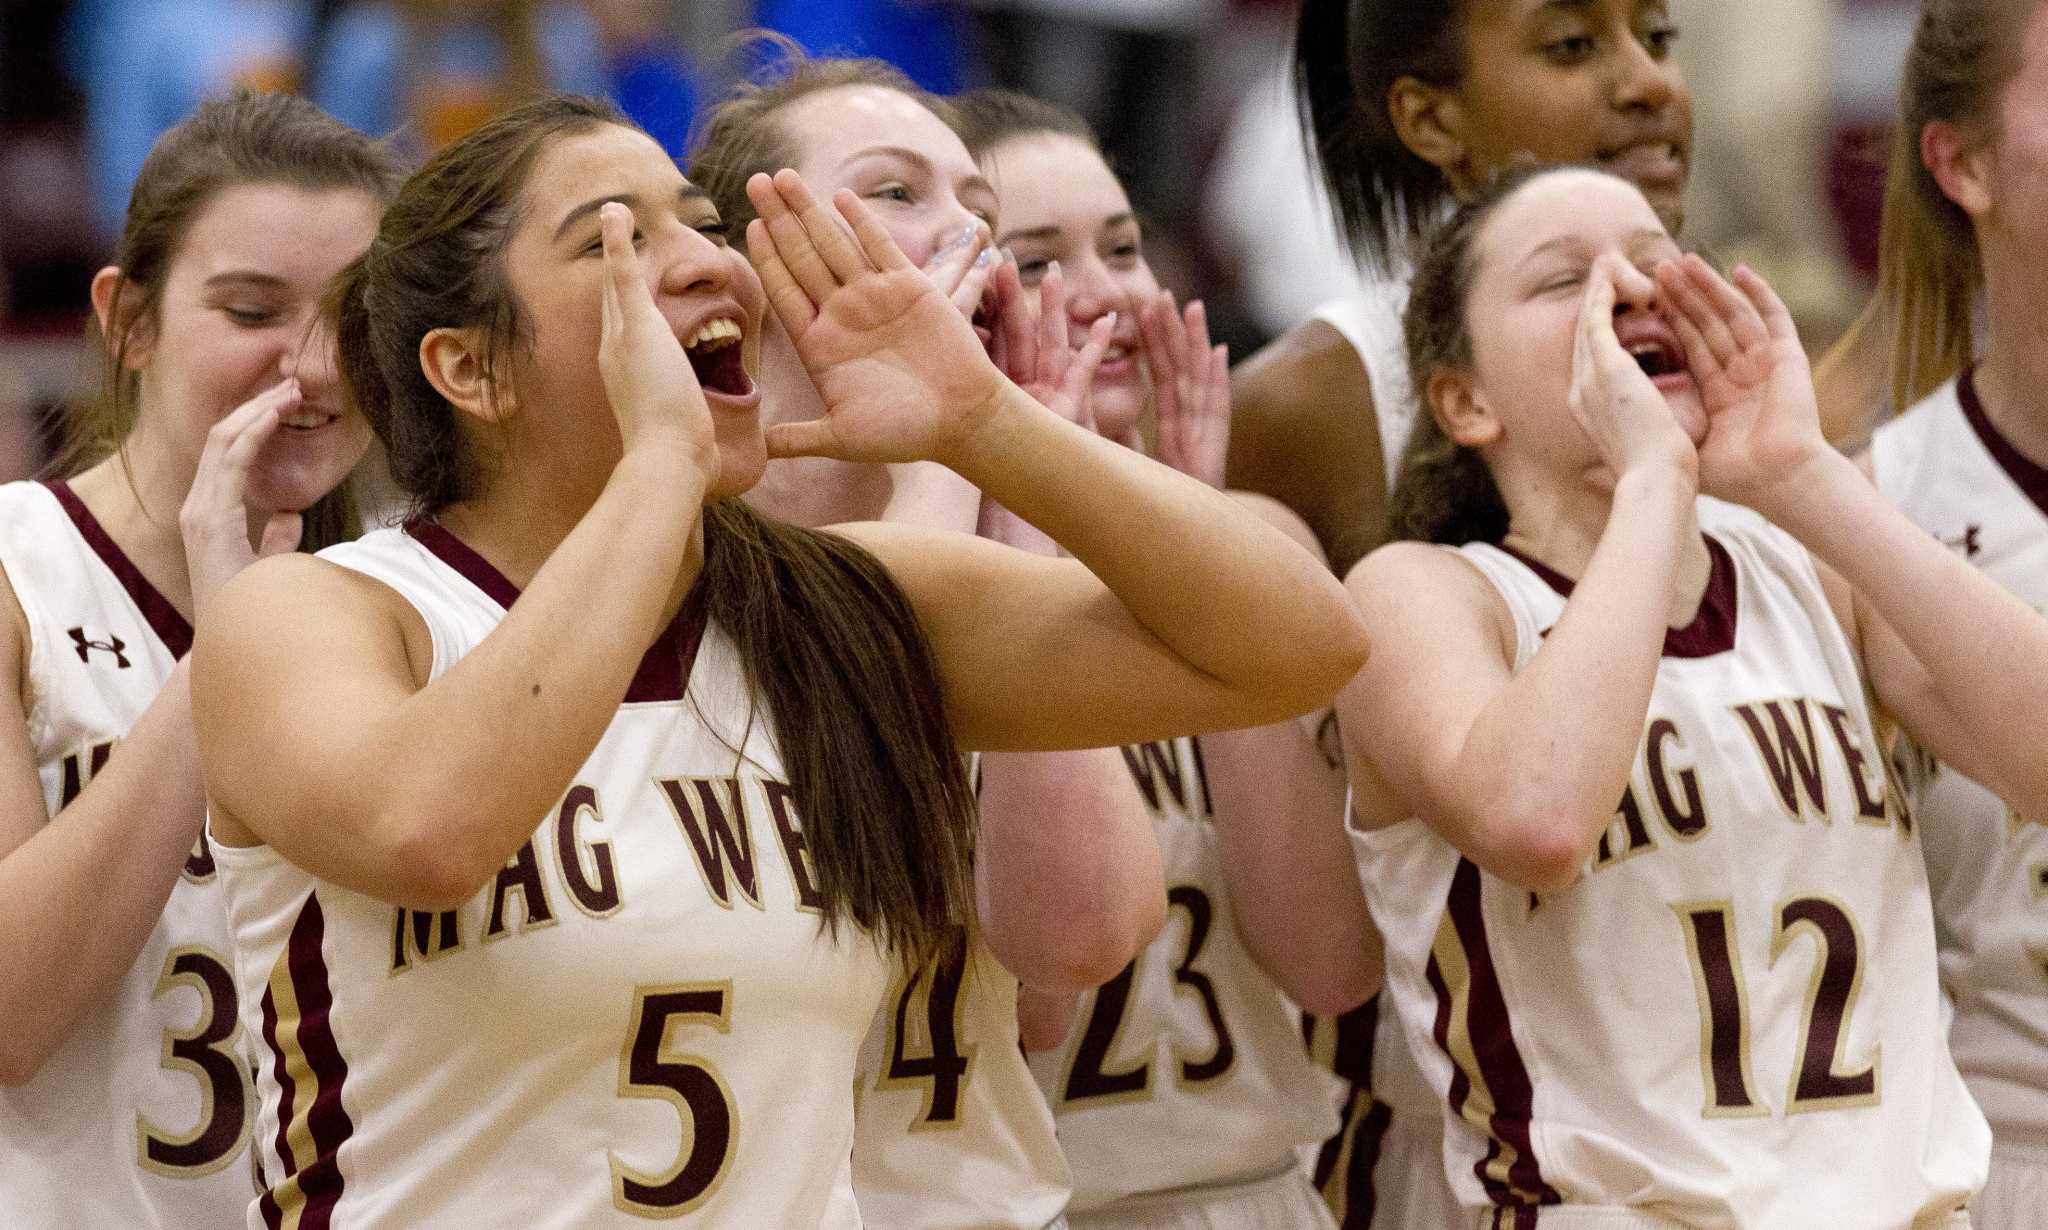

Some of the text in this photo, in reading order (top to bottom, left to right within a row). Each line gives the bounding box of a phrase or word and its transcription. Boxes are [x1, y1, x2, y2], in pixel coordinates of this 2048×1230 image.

[650, 775, 872, 932] WE
[1728, 696, 1917, 840] WE
[136, 943, 266, 1196] 3
[609, 979, 739, 1219] 5
[855, 915, 978, 1131] 4
[1054, 885, 1236, 1115] 23
[1675, 896, 1882, 1118] 12
